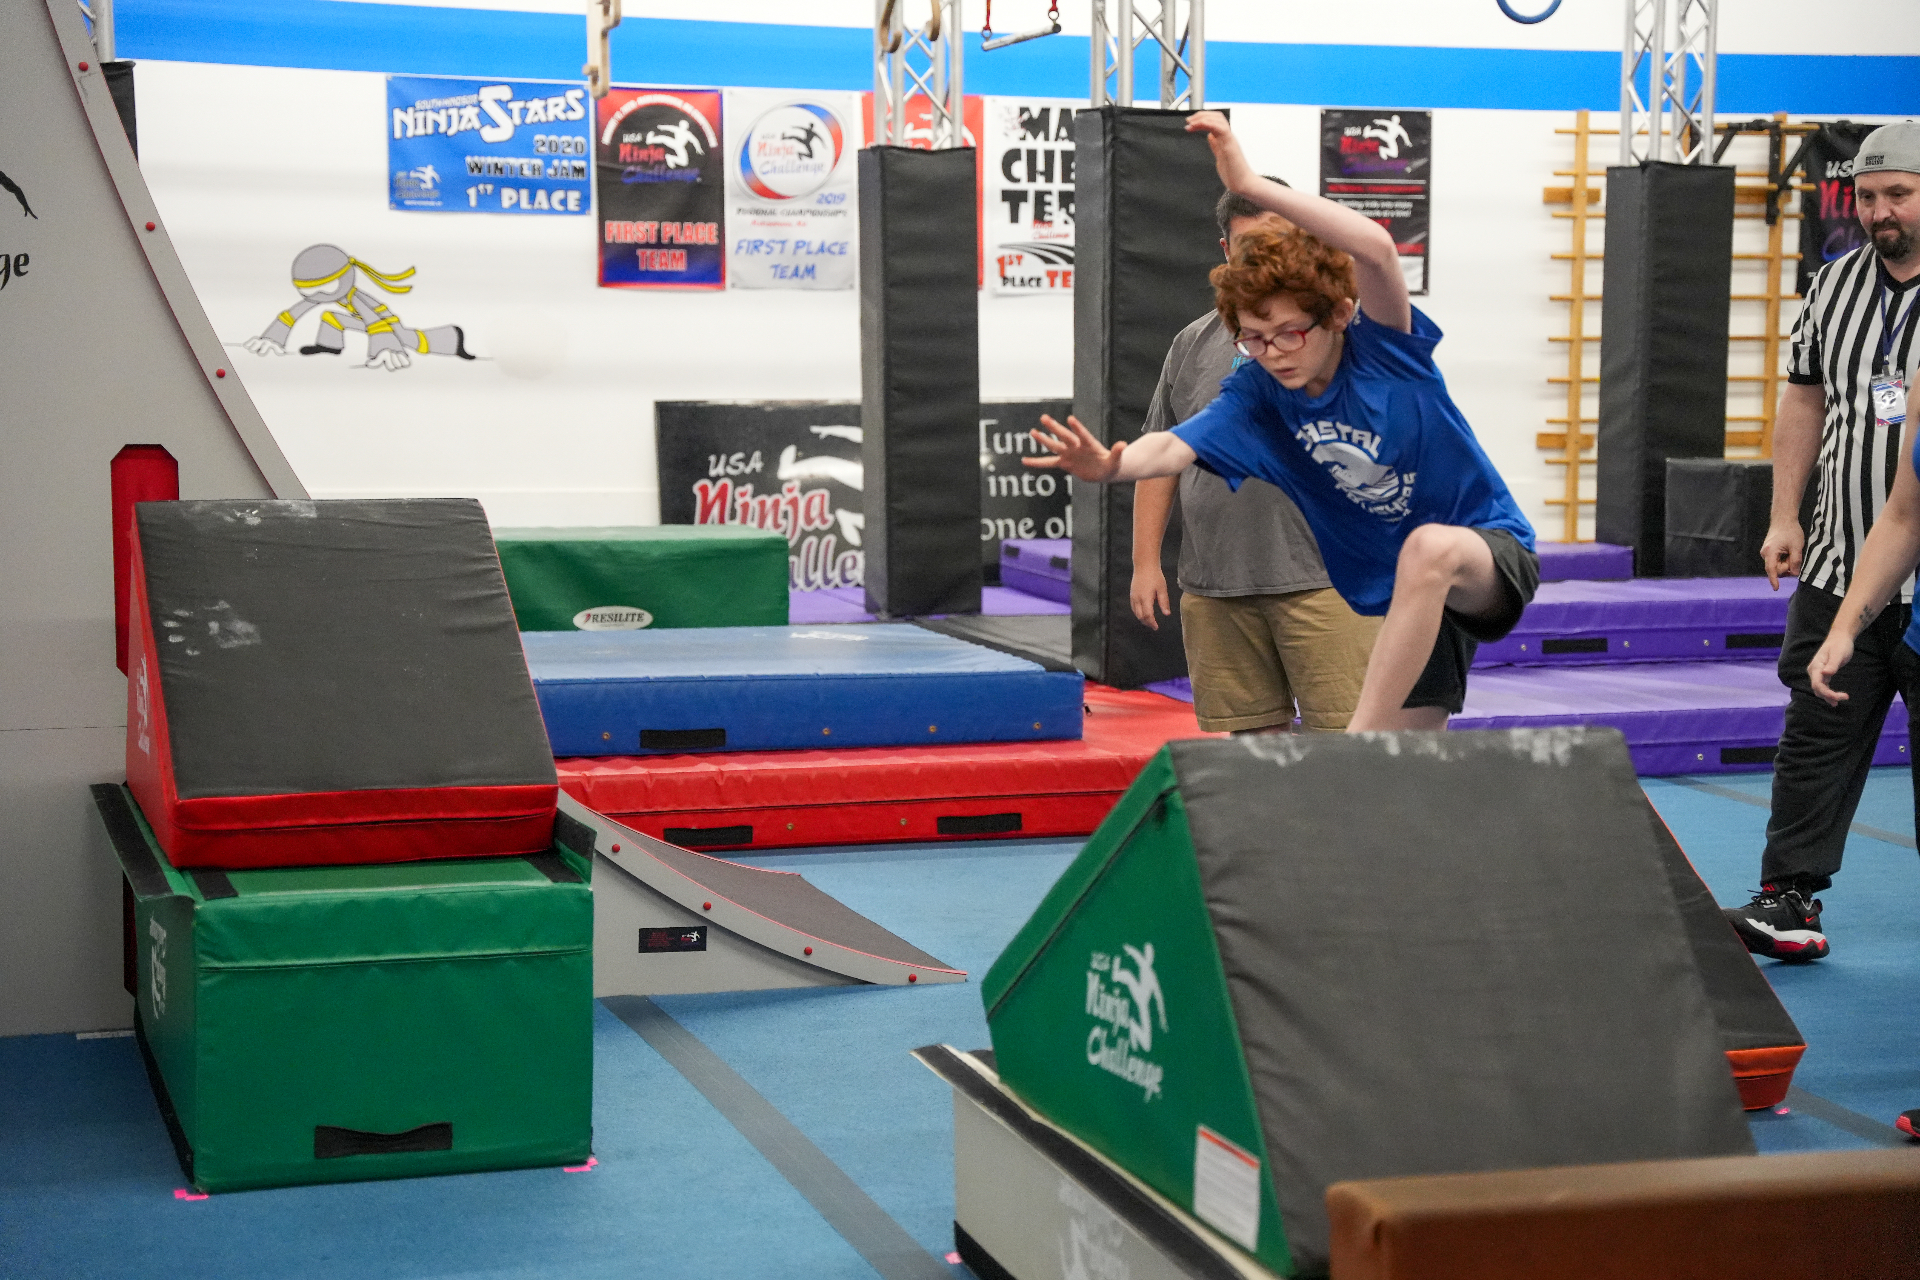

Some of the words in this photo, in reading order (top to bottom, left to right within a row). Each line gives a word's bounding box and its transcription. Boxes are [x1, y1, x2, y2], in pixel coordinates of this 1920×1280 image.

[393, 106, 482, 139] NINJA
[1019, 107, 1076, 142] MA
[533, 134, 587, 155] 2020
[757, 141, 796, 157] Ninja
[464, 155, 544, 177] WINTER
[547, 158, 587, 179] JAM
[760, 160, 827, 175] Challenge
[1001, 148, 1076, 183] CHE
[1825, 160, 1854, 178] US
[500, 187, 582, 212] PLACE
[816, 193, 847, 205] 2019
[604, 220, 659, 244] FIRST
[660, 221, 720, 245] PLACE
[735, 239, 788, 255] FIRST
[792, 240, 849, 255] PLACE
[636, 248, 688, 272] TEAM
[770, 263, 817, 280] TEAM
[1002, 277, 1043, 288] PLACE
[1046, 270, 1073, 288] TE
[708, 450, 765, 477] USA
[987, 462, 1057, 497] into
[693, 477, 835, 548] Ninja
[591, 612, 645, 624] RESILITE
[1086, 971, 1130, 1037] Ninja
[1086, 1026, 1163, 1102] Challenge
